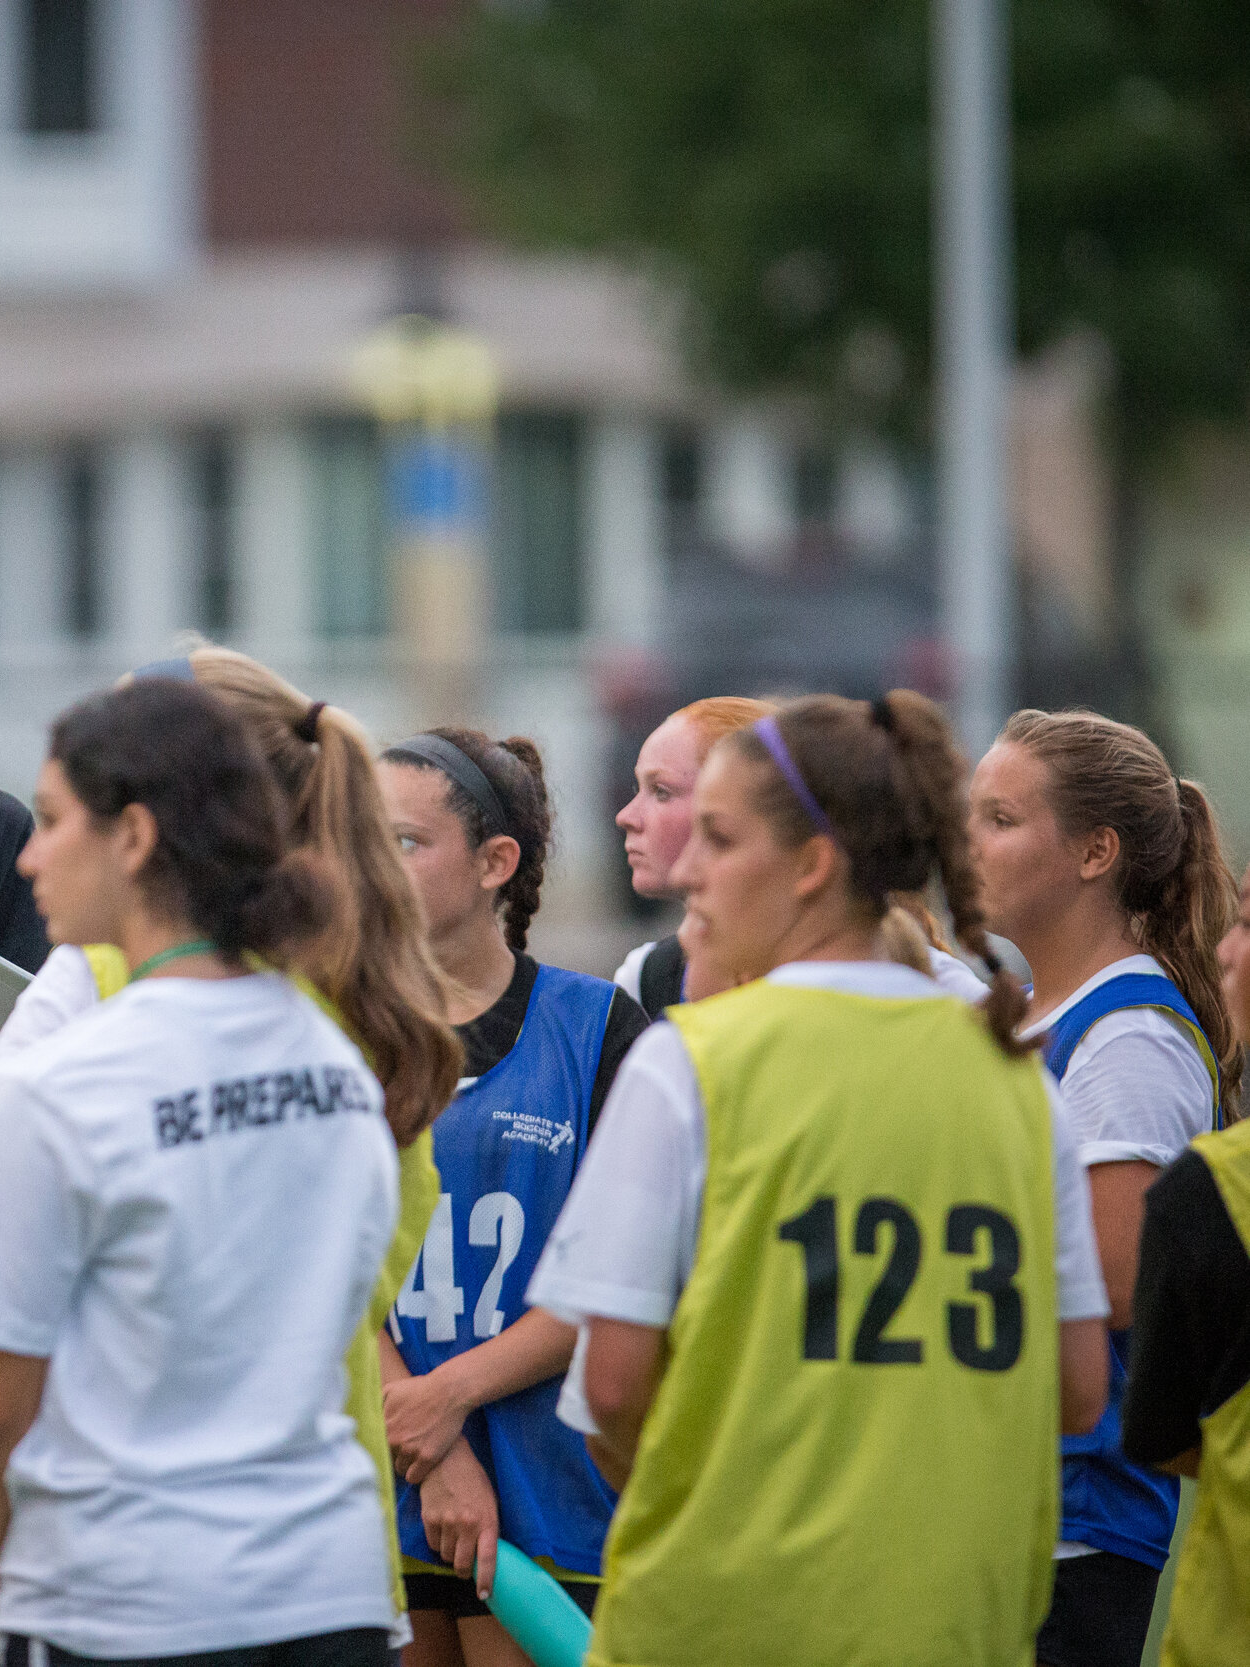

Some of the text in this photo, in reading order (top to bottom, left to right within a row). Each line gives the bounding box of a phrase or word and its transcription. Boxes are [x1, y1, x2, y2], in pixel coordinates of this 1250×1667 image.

[154, 1089, 202, 1149] BE
[492, 1111, 553, 1129] COLLEGIATE
[502, 1130, 550, 1147] ACADEMY
[513, 1120, 552, 1138] SOCCER
[389, 1191, 525, 1343] 42
[778, 1194, 1023, 1374] 123
